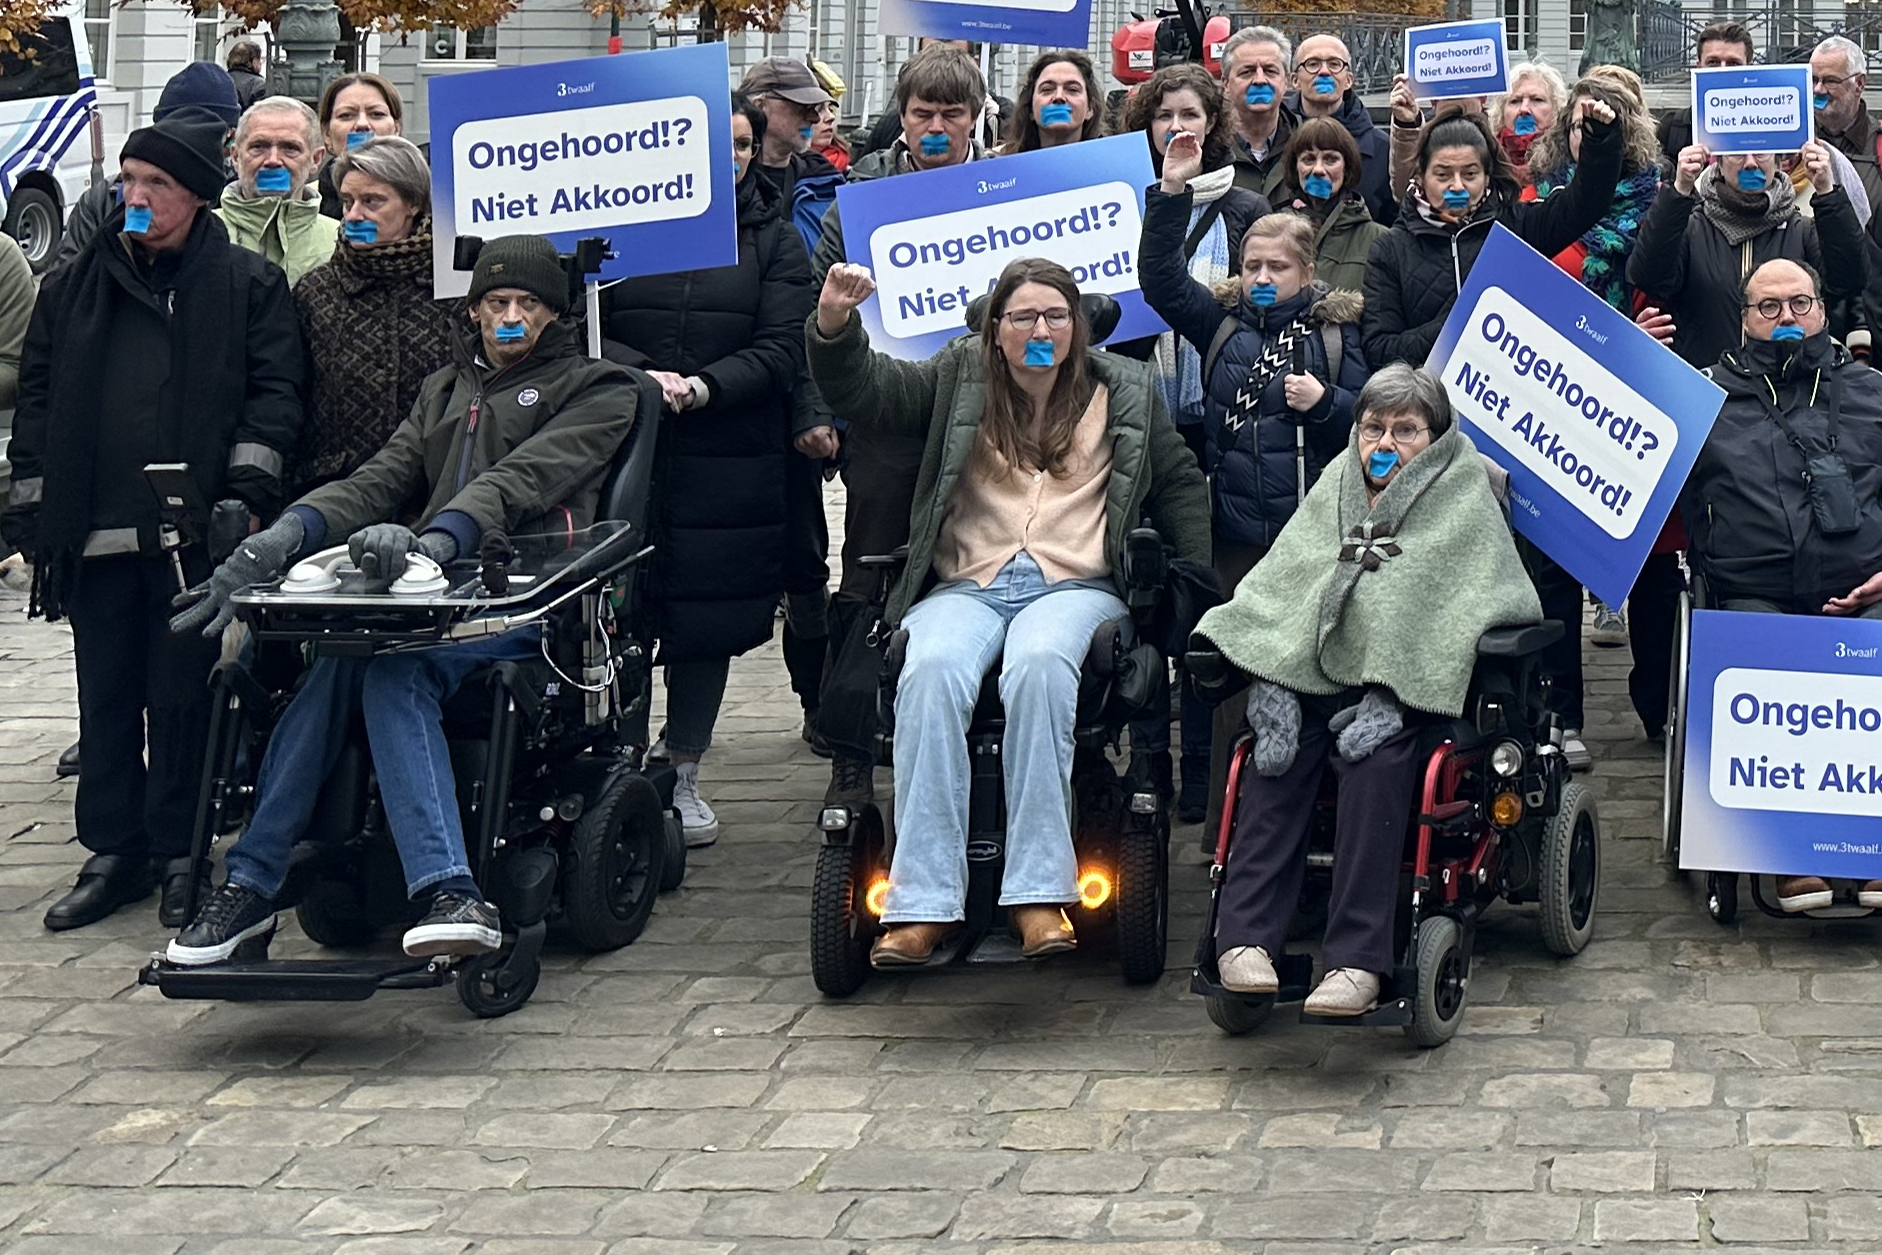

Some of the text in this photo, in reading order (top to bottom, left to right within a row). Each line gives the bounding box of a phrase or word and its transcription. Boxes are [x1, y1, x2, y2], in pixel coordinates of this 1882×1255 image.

[1420, 45, 1490, 61] Ongehoord!?
[1420, 63, 1491, 77] Niet Akkoord!
[1710, 94, 1793, 109] Ongehoord!?
[1711, 115, 1794, 126] Niet Akkoord!
[468, 118, 692, 171] Ongehoord!?
[472, 174, 694, 223] Niet Akkoord!
[889, 202, 1122, 268] Ongehoord!?
[899, 285, 970, 319] Niet
[1482, 313, 1659, 460] Ongehoord!?
[1455, 362, 1632, 517] Niet Akkoord!
[1835, 642, 1878, 658] 3twaalf
[1729, 755, 1805, 790] Niet
